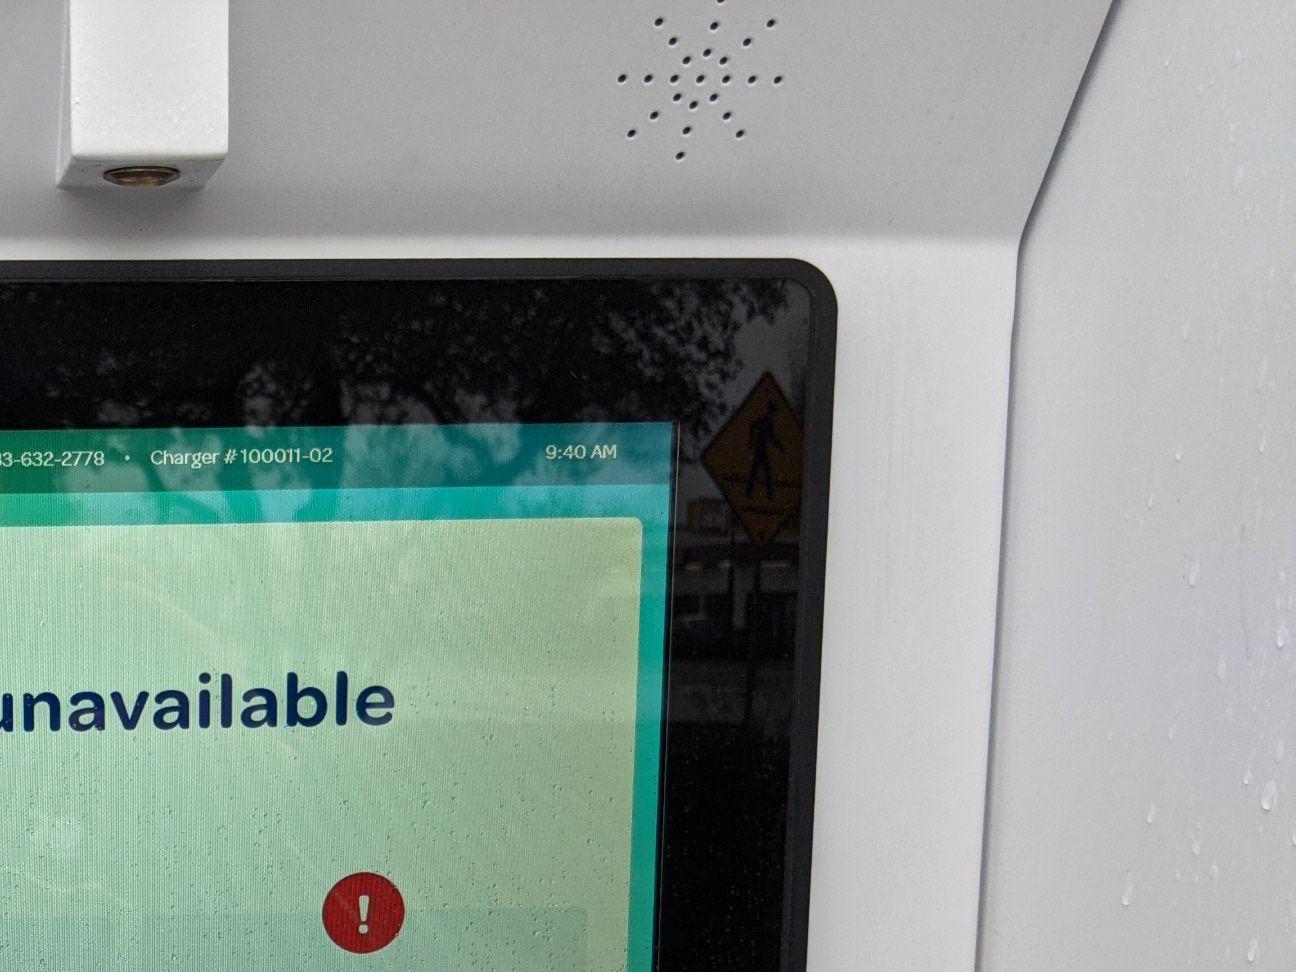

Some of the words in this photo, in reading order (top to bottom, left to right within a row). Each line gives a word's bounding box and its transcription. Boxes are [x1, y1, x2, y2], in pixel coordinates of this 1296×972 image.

[150, 450, 220, 469] Charger
[545, 444, 587, 460] 9:40
[590, 444, 617, 459] AM
